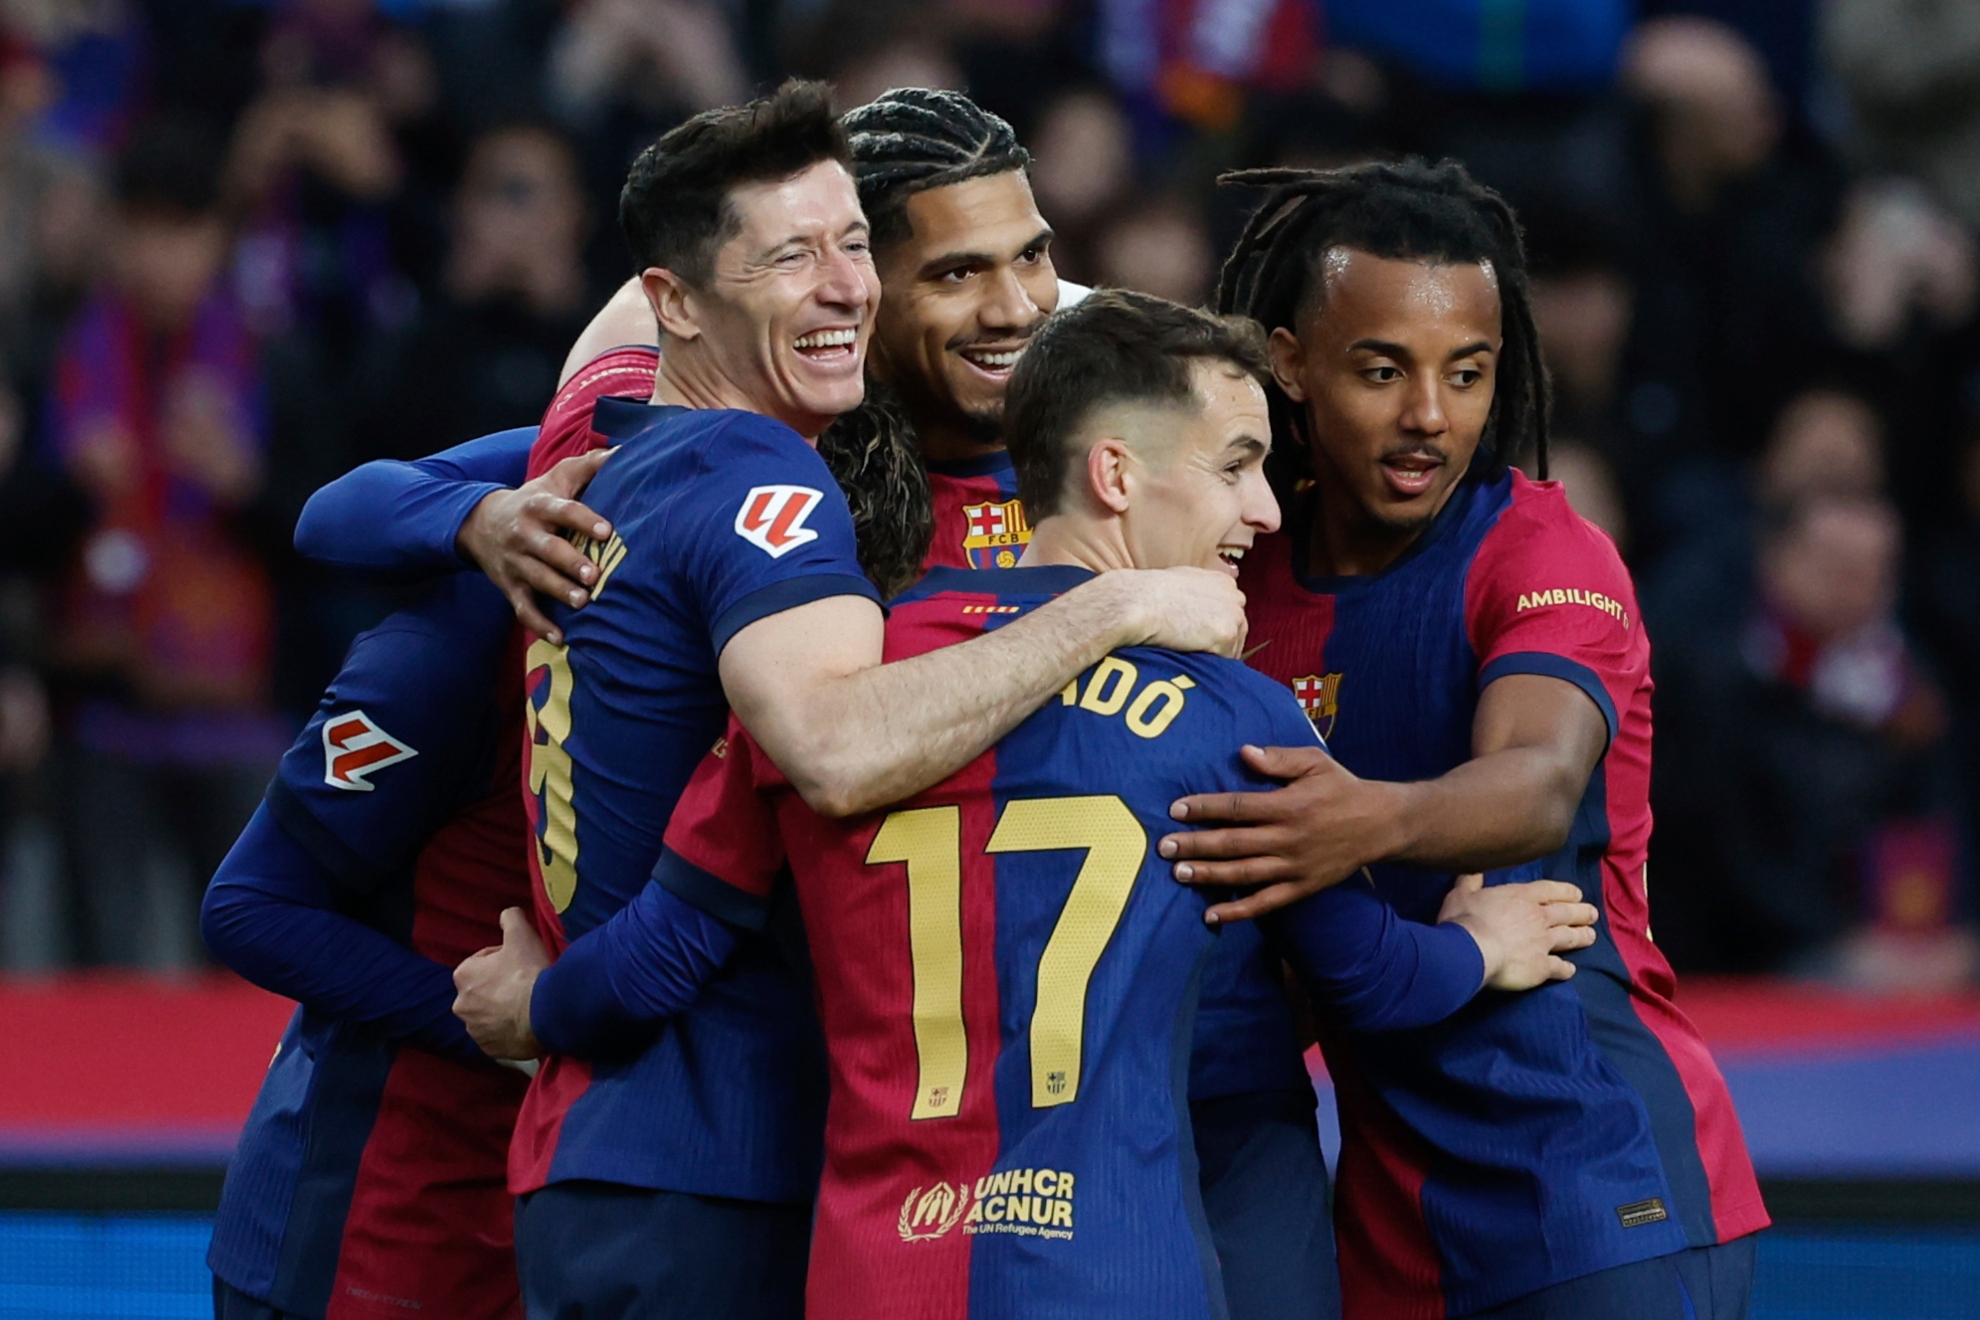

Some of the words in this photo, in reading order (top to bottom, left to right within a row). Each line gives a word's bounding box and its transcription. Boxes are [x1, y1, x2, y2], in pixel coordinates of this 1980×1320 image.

[1517, 588, 1623, 621] AMBILIGHT
[865, 795, 1147, 1120] 17
[973, 1168, 1075, 1200] UNHCR
[963, 1195, 1073, 1227] ACNUR
[963, 1225, 978, 1235] The
[979, 1224, 994, 1234] UN
[995, 1224, 1037, 1236] Refugee
[1038, 1226, 1074, 1241] Agency
